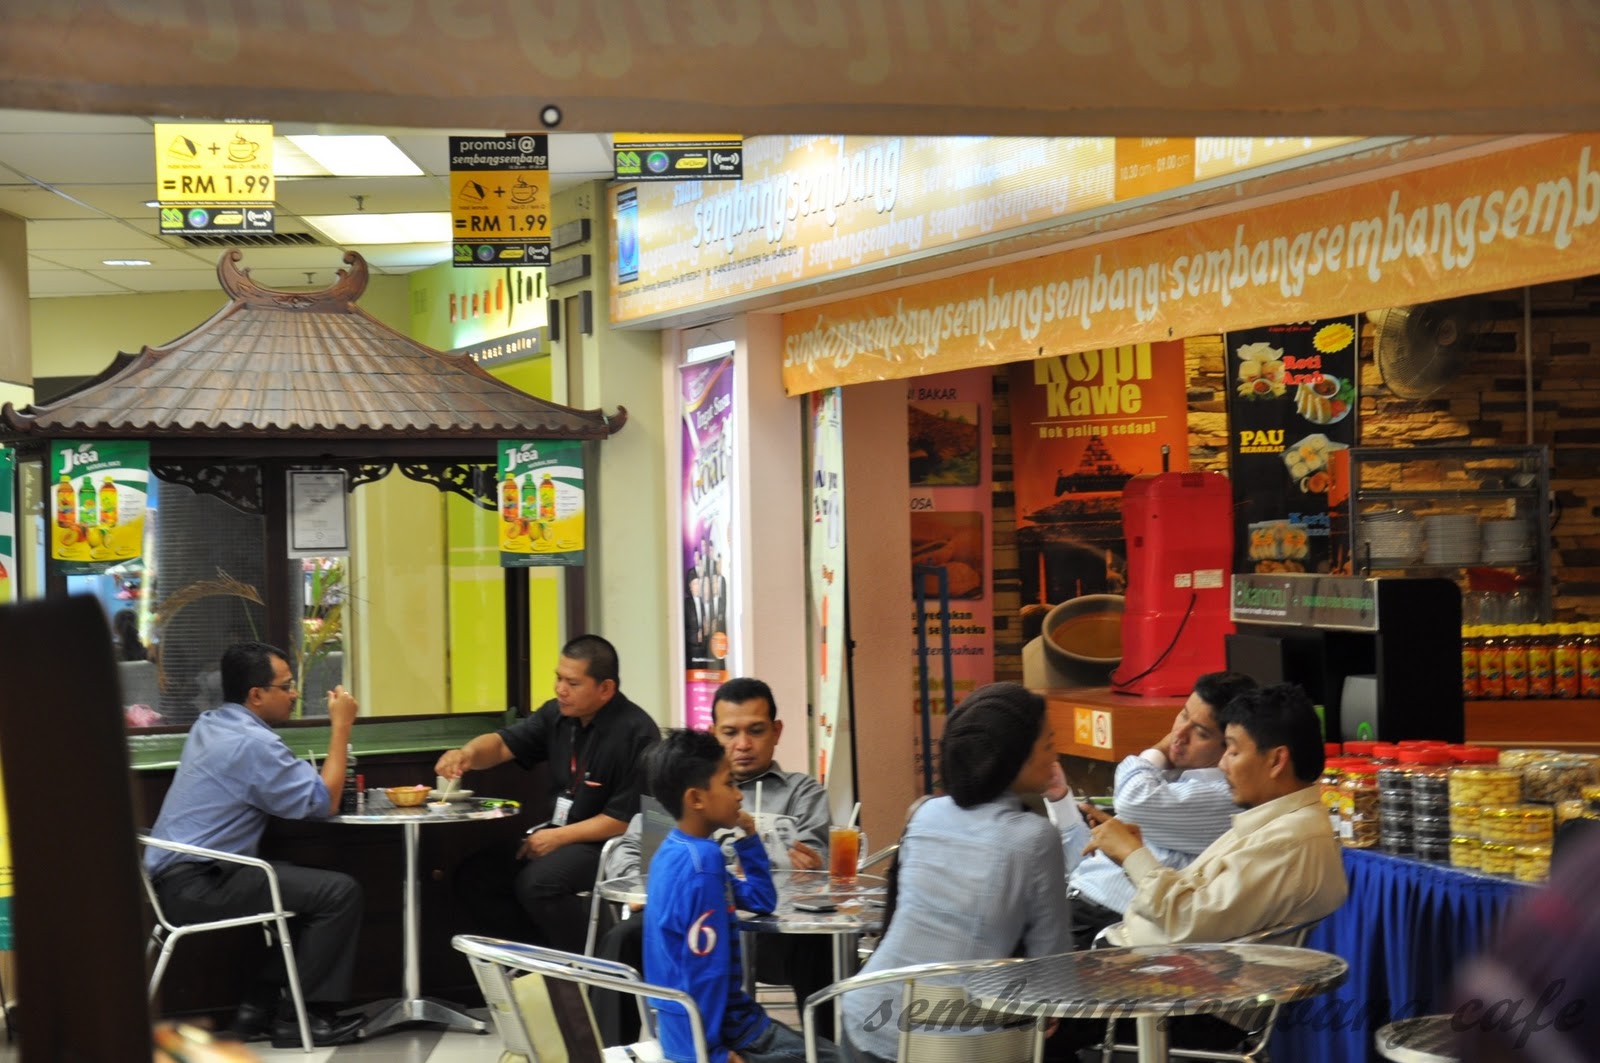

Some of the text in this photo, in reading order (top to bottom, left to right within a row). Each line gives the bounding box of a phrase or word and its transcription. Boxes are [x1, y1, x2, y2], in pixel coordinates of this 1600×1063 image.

[452, 154, 547, 166] sembangsembang
[182, 175, 215, 193] RM
[225, 175, 270, 194] 1.99
[471, 215, 501, 232] RM
[509, 214, 547, 232] 1.99
[918, 388, 957, 400] BAKAR
[1047, 383, 1142, 417] Kawe
[1067, 424, 1108, 438] paling
[1112, 421, 1156, 435] sedap!
[1240, 429, 1285, 445] PAU
[688, 909, 717, 955] 6
